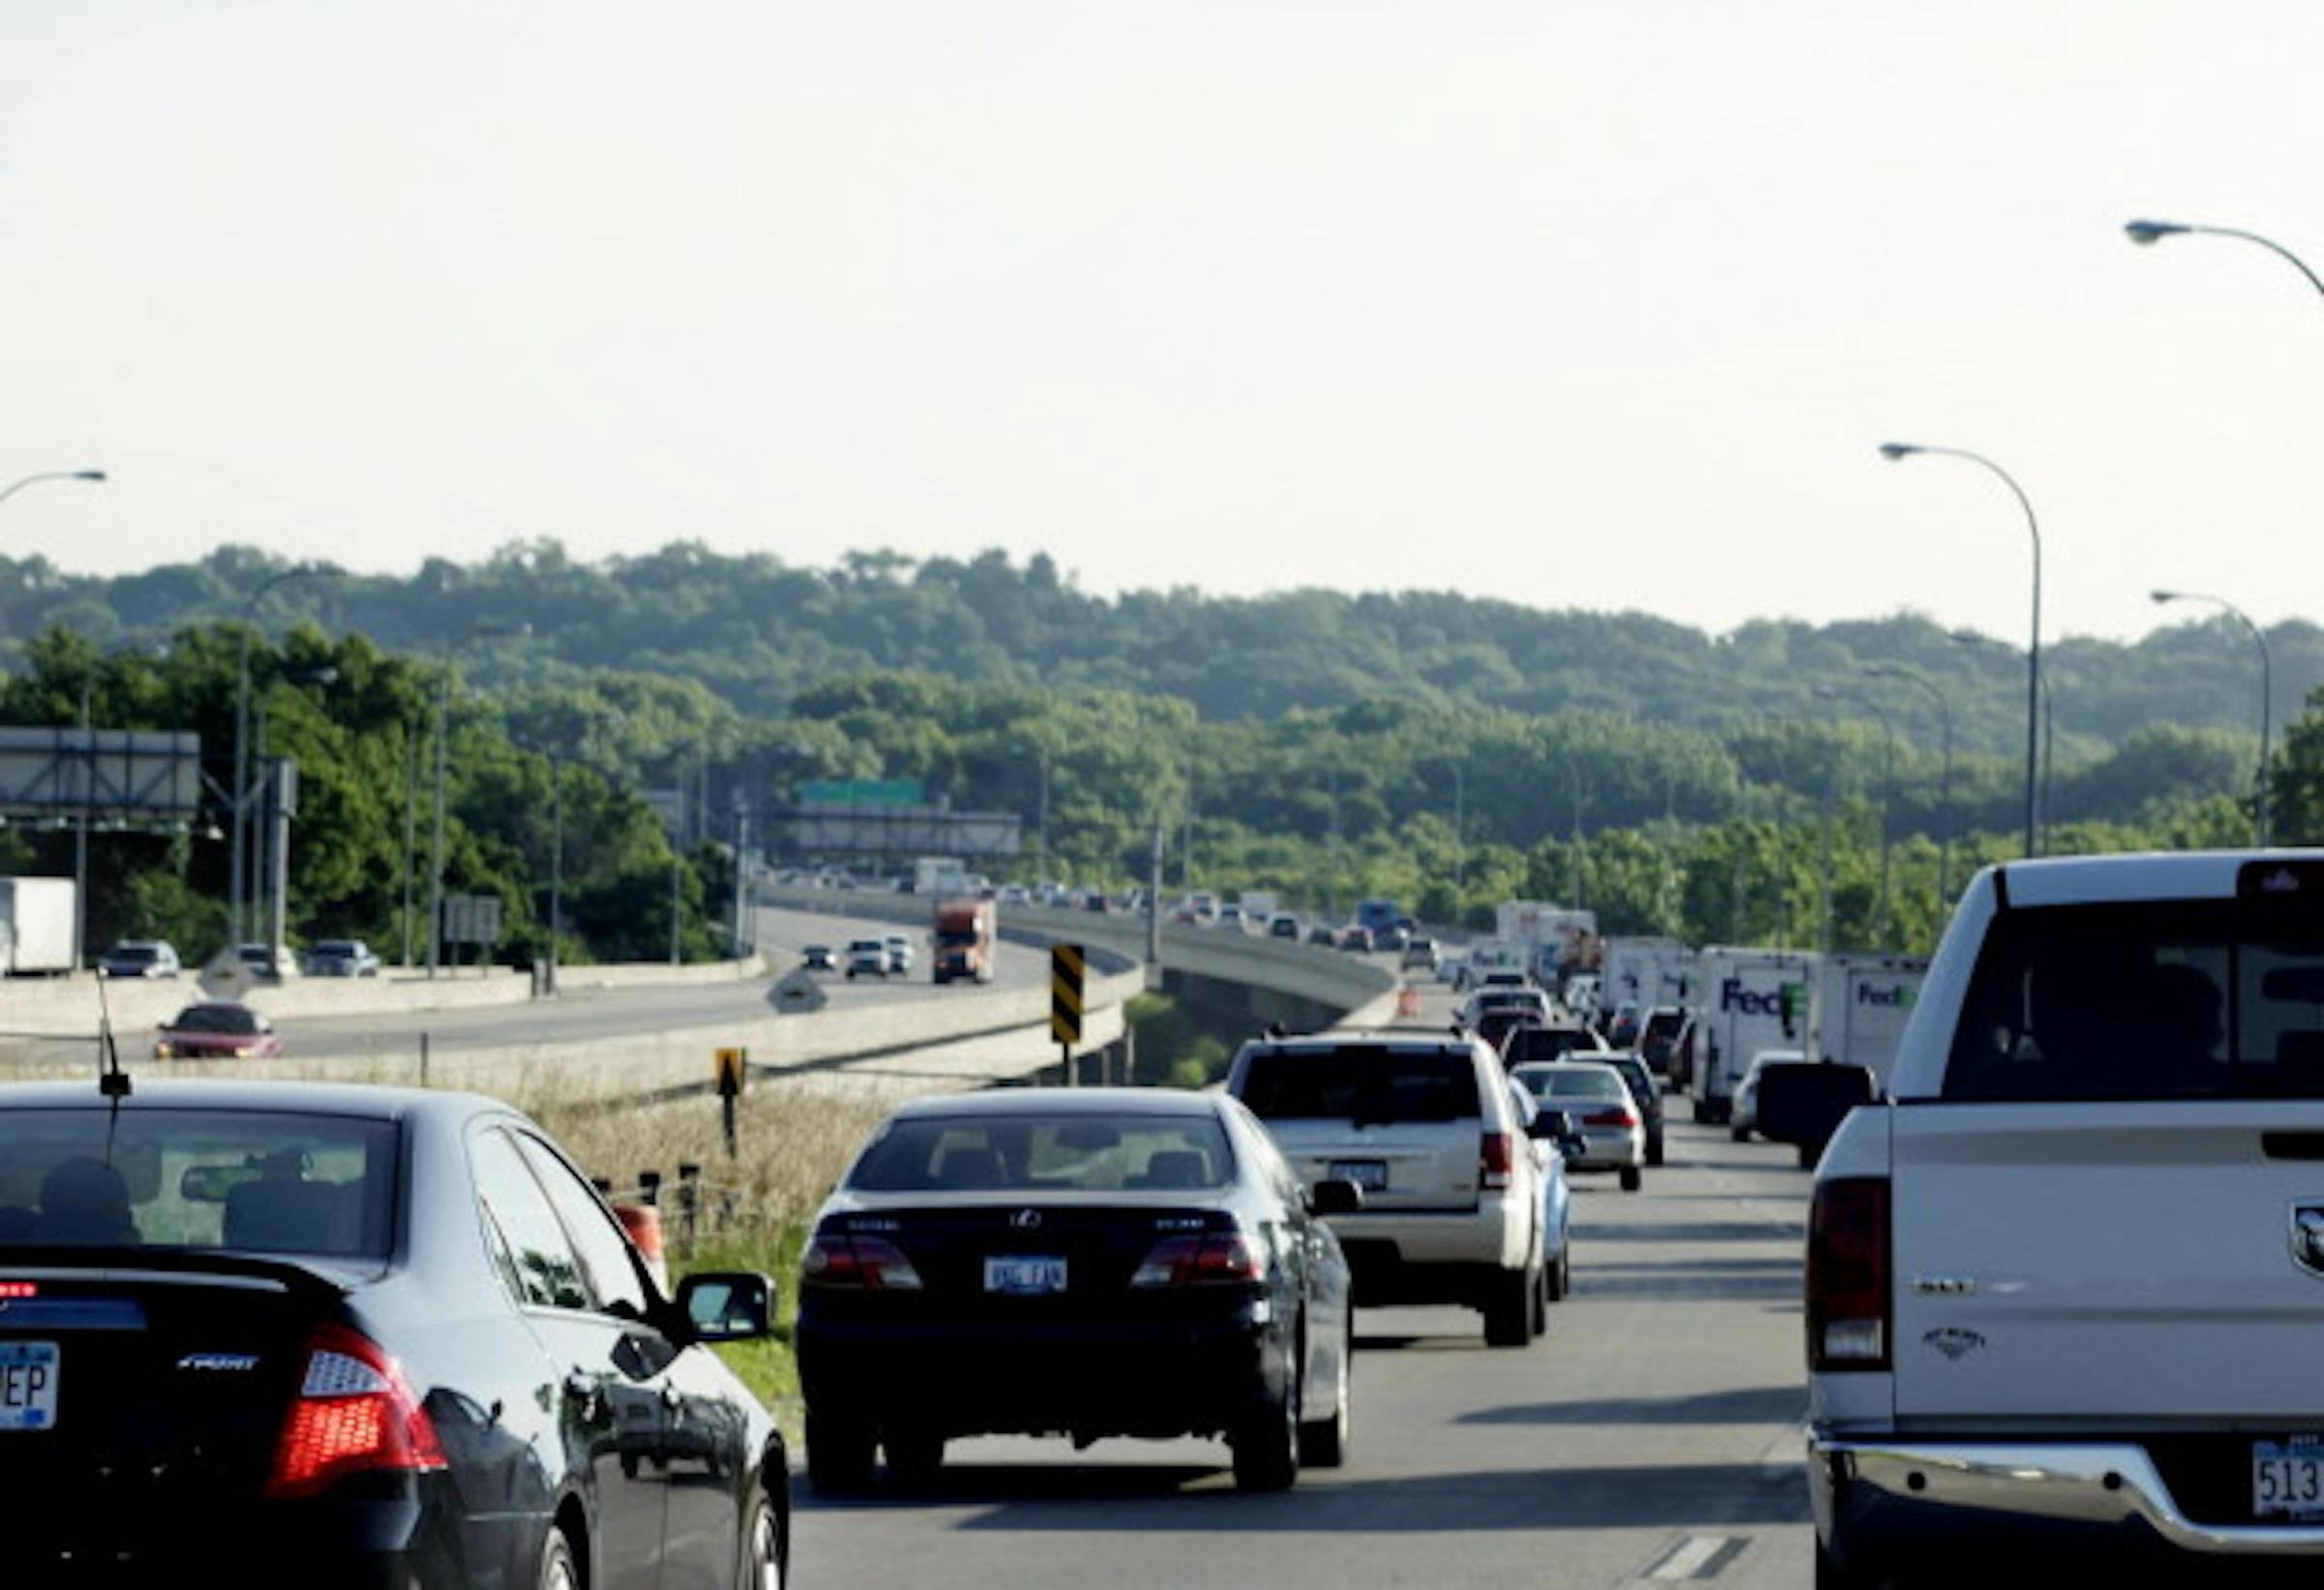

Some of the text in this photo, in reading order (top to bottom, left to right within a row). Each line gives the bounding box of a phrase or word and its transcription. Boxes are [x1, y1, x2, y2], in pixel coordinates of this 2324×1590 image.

[1722, 979, 1808, 1016] FedE
[1858, 982, 1916, 1006] FedE
[0, 1364, 46, 1407] EP
[2261, 1460, 2317, 1502] 513
